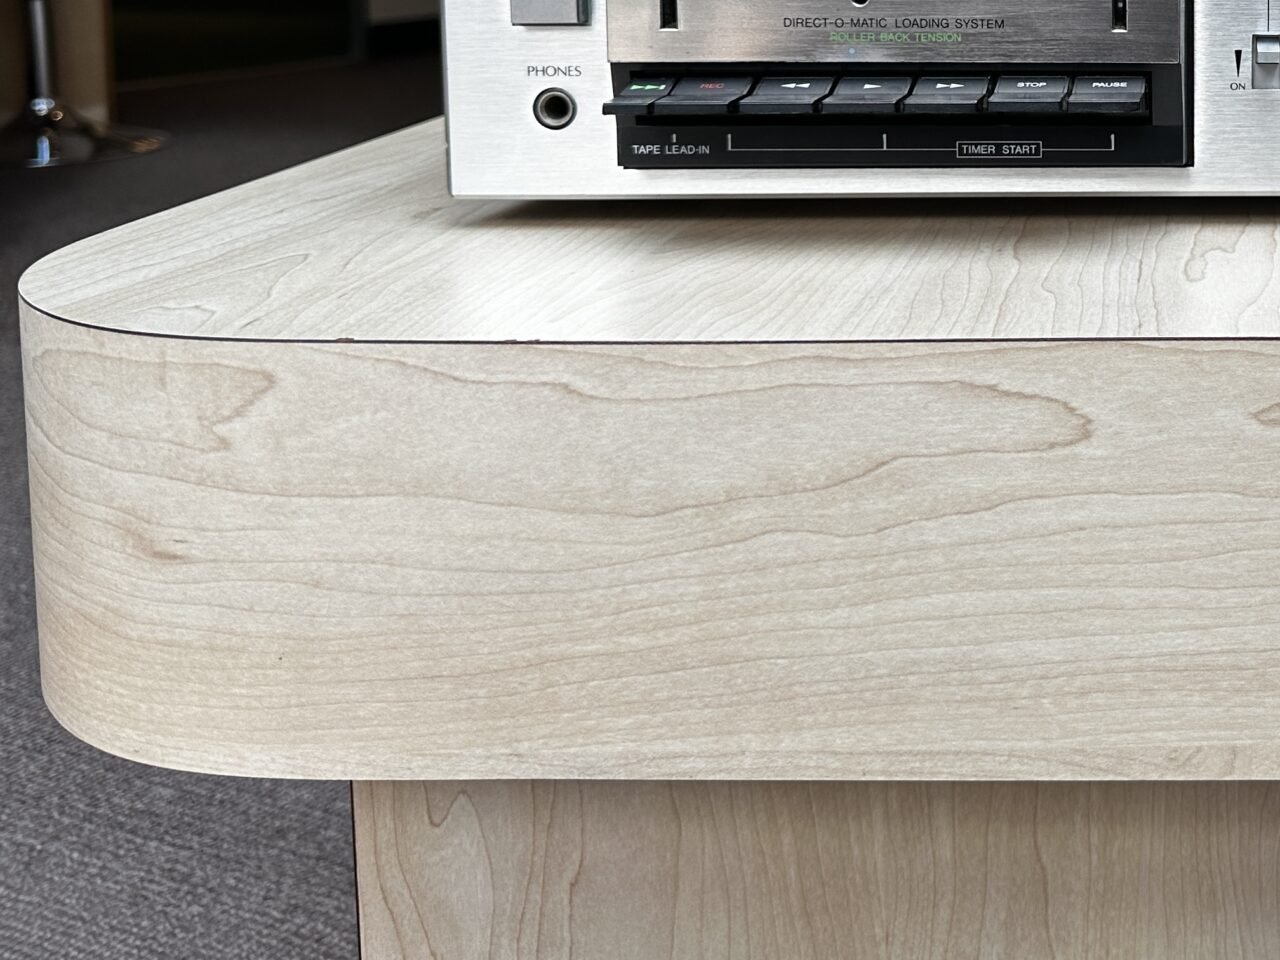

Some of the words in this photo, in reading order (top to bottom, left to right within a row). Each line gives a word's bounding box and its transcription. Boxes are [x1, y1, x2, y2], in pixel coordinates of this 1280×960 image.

[783, 17, 888, 29] DIRECT-O-MATIC
[894, 17, 950, 30] LOADING
[954, 18, 1006, 30] SYSTEM
[829, 32, 876, 42] ROLLER
[880, 32, 910, 42] BACK
[914, 32, 962, 42] TENSION
[526, 64, 582, 78] PHONES
[700, 80, 726, 90] REC
[1016, 80, 1047, 88] STOP
[1092, 80, 1128, 88] PAUSE
[1230, 82, 1246, 91] ON
[632, 144, 662, 156] TAPE
[664, 144, 710, 156] LEAD-IN
[962, 144, 996, 155] TIMER
[1002, 144, 1037, 155] START
